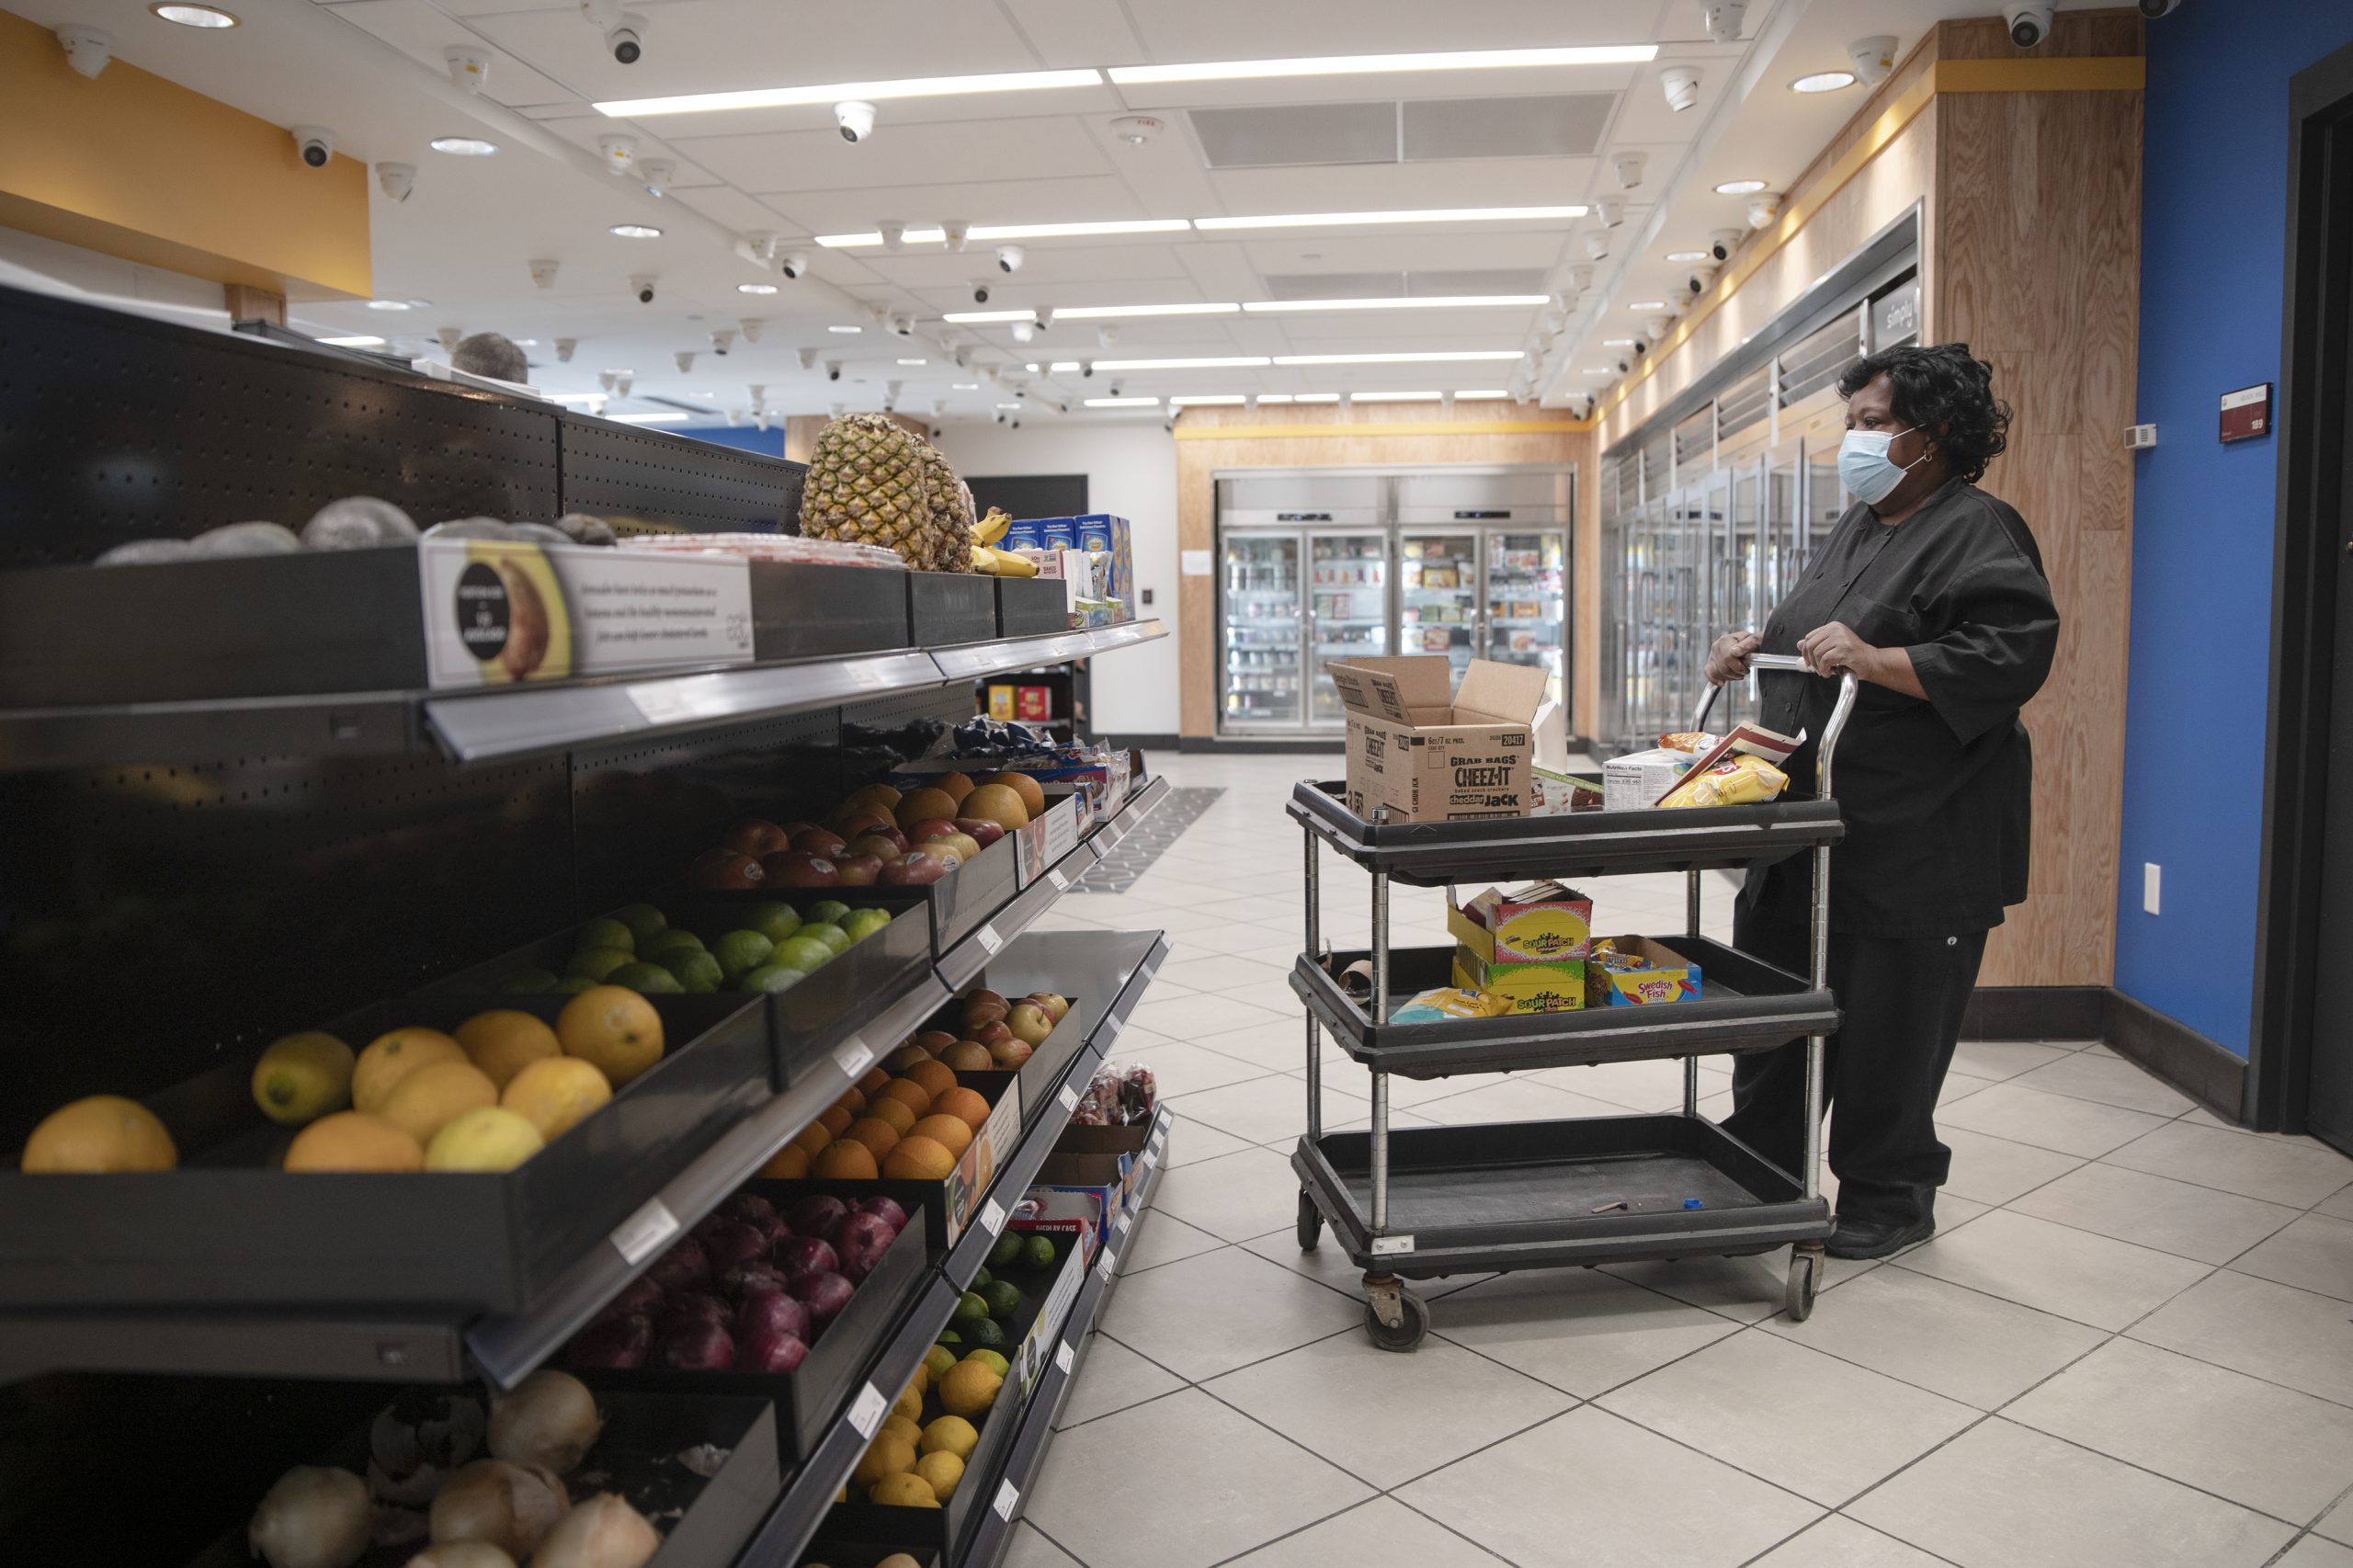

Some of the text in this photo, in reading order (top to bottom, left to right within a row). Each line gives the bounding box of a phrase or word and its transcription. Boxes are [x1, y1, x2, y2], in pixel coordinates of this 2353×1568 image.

[1887, 300, 1913, 329] simply
[1503, 735, 1524, 745] 20417
[1450, 755, 1517, 767] GRAB BAGS
[1449, 794, 1483, 805] cheddar
[1523, 938, 1548, 949] SOUR
[1548, 937, 1574, 948] PATCH
[1606, 955, 1628, 964] mini
[1638, 980, 1673, 994] Swedish
[1646, 989, 1666, 999] Fish
[1518, 998, 1546, 1010] SOUR
[1546, 996, 1576, 1008] PATCH
